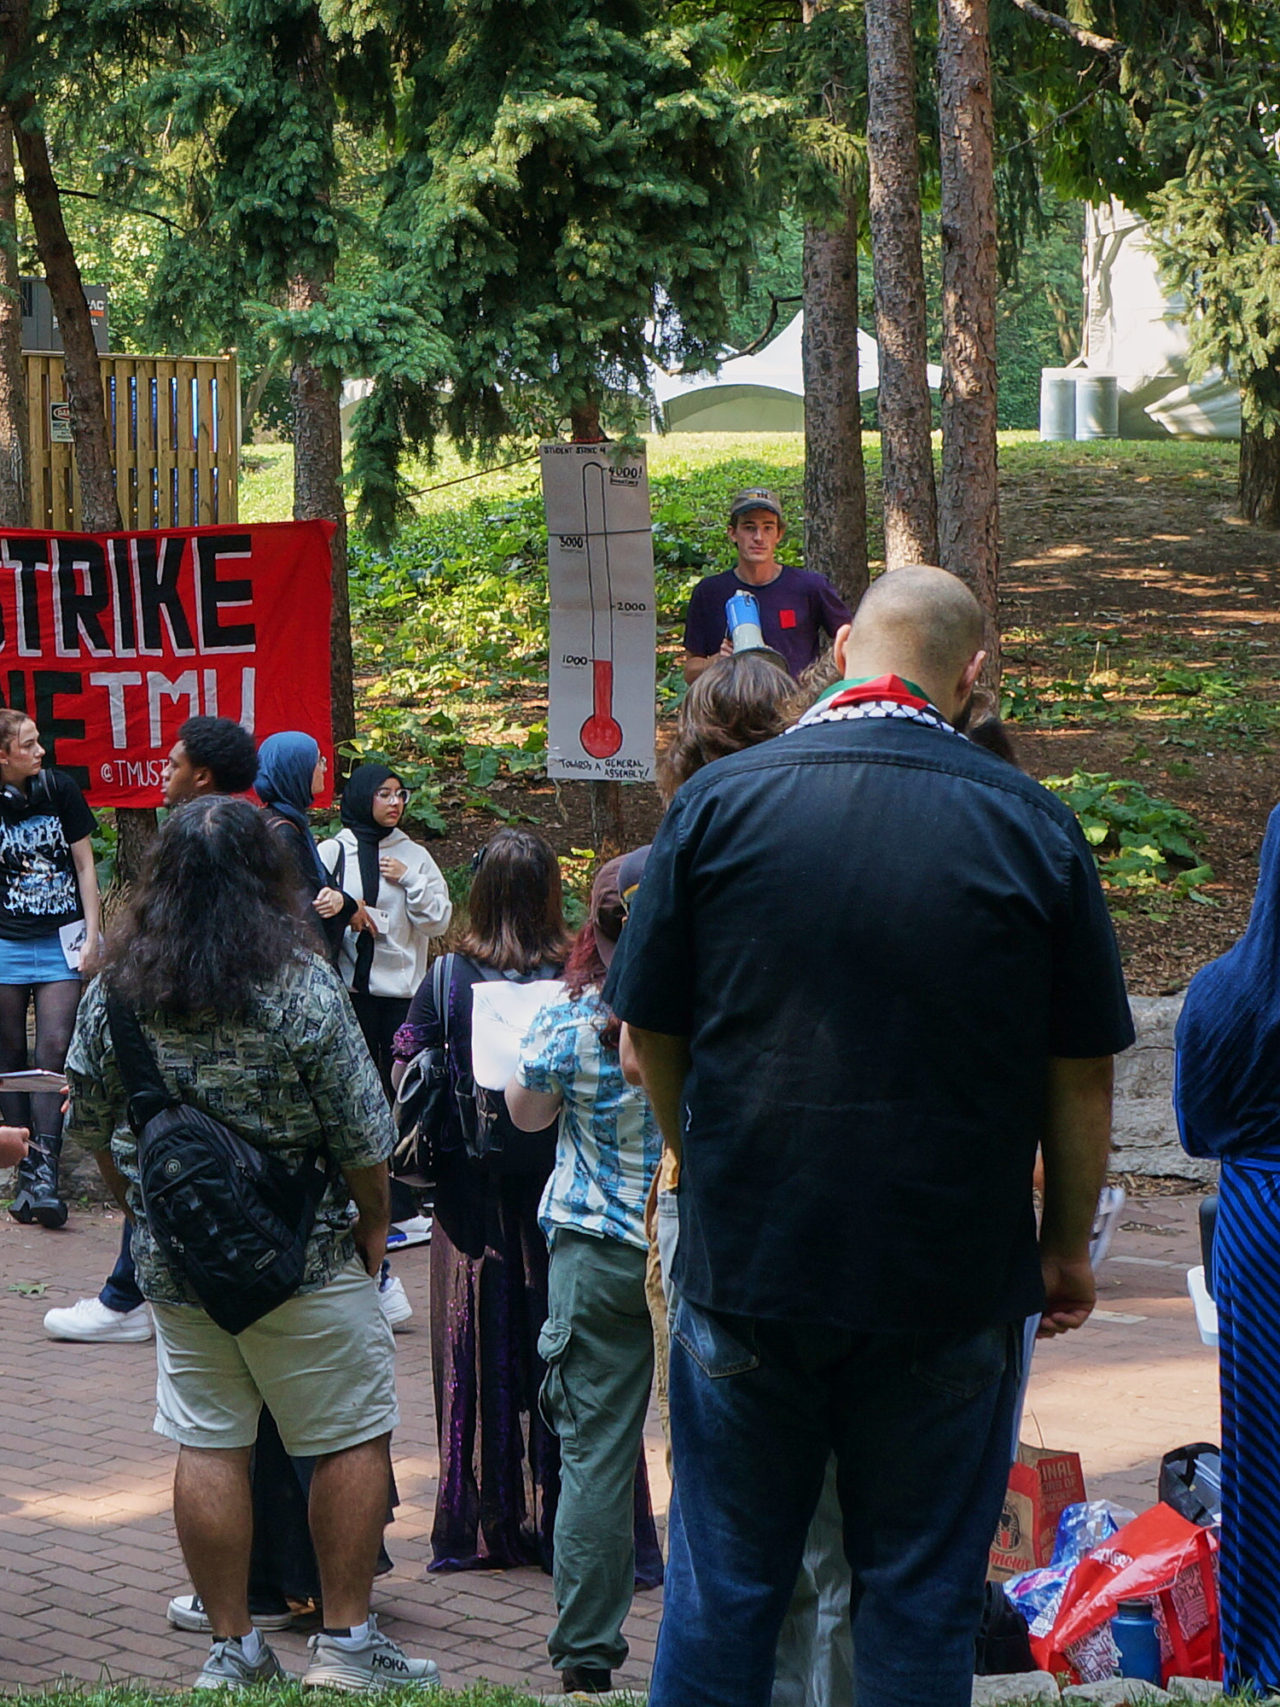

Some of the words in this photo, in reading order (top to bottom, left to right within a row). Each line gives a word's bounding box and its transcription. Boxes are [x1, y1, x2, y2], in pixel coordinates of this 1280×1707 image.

[544, 446, 573, 455] STUDENT
[609, 465, 642, 479] 4000!
[617, 602, 646, 612] 2000
[562, 654, 588, 666] 1000
[89, 667, 256, 749] TMU
[100, 758, 170, 787] @TMUST
[595, 762, 601, 771] A
[604, 759, 644, 769] GENERAL
[1042, 1460, 1075, 1481] INAL
[990, 1550, 1031, 1572] mous
[371, 1652, 410, 1673] HOKA
